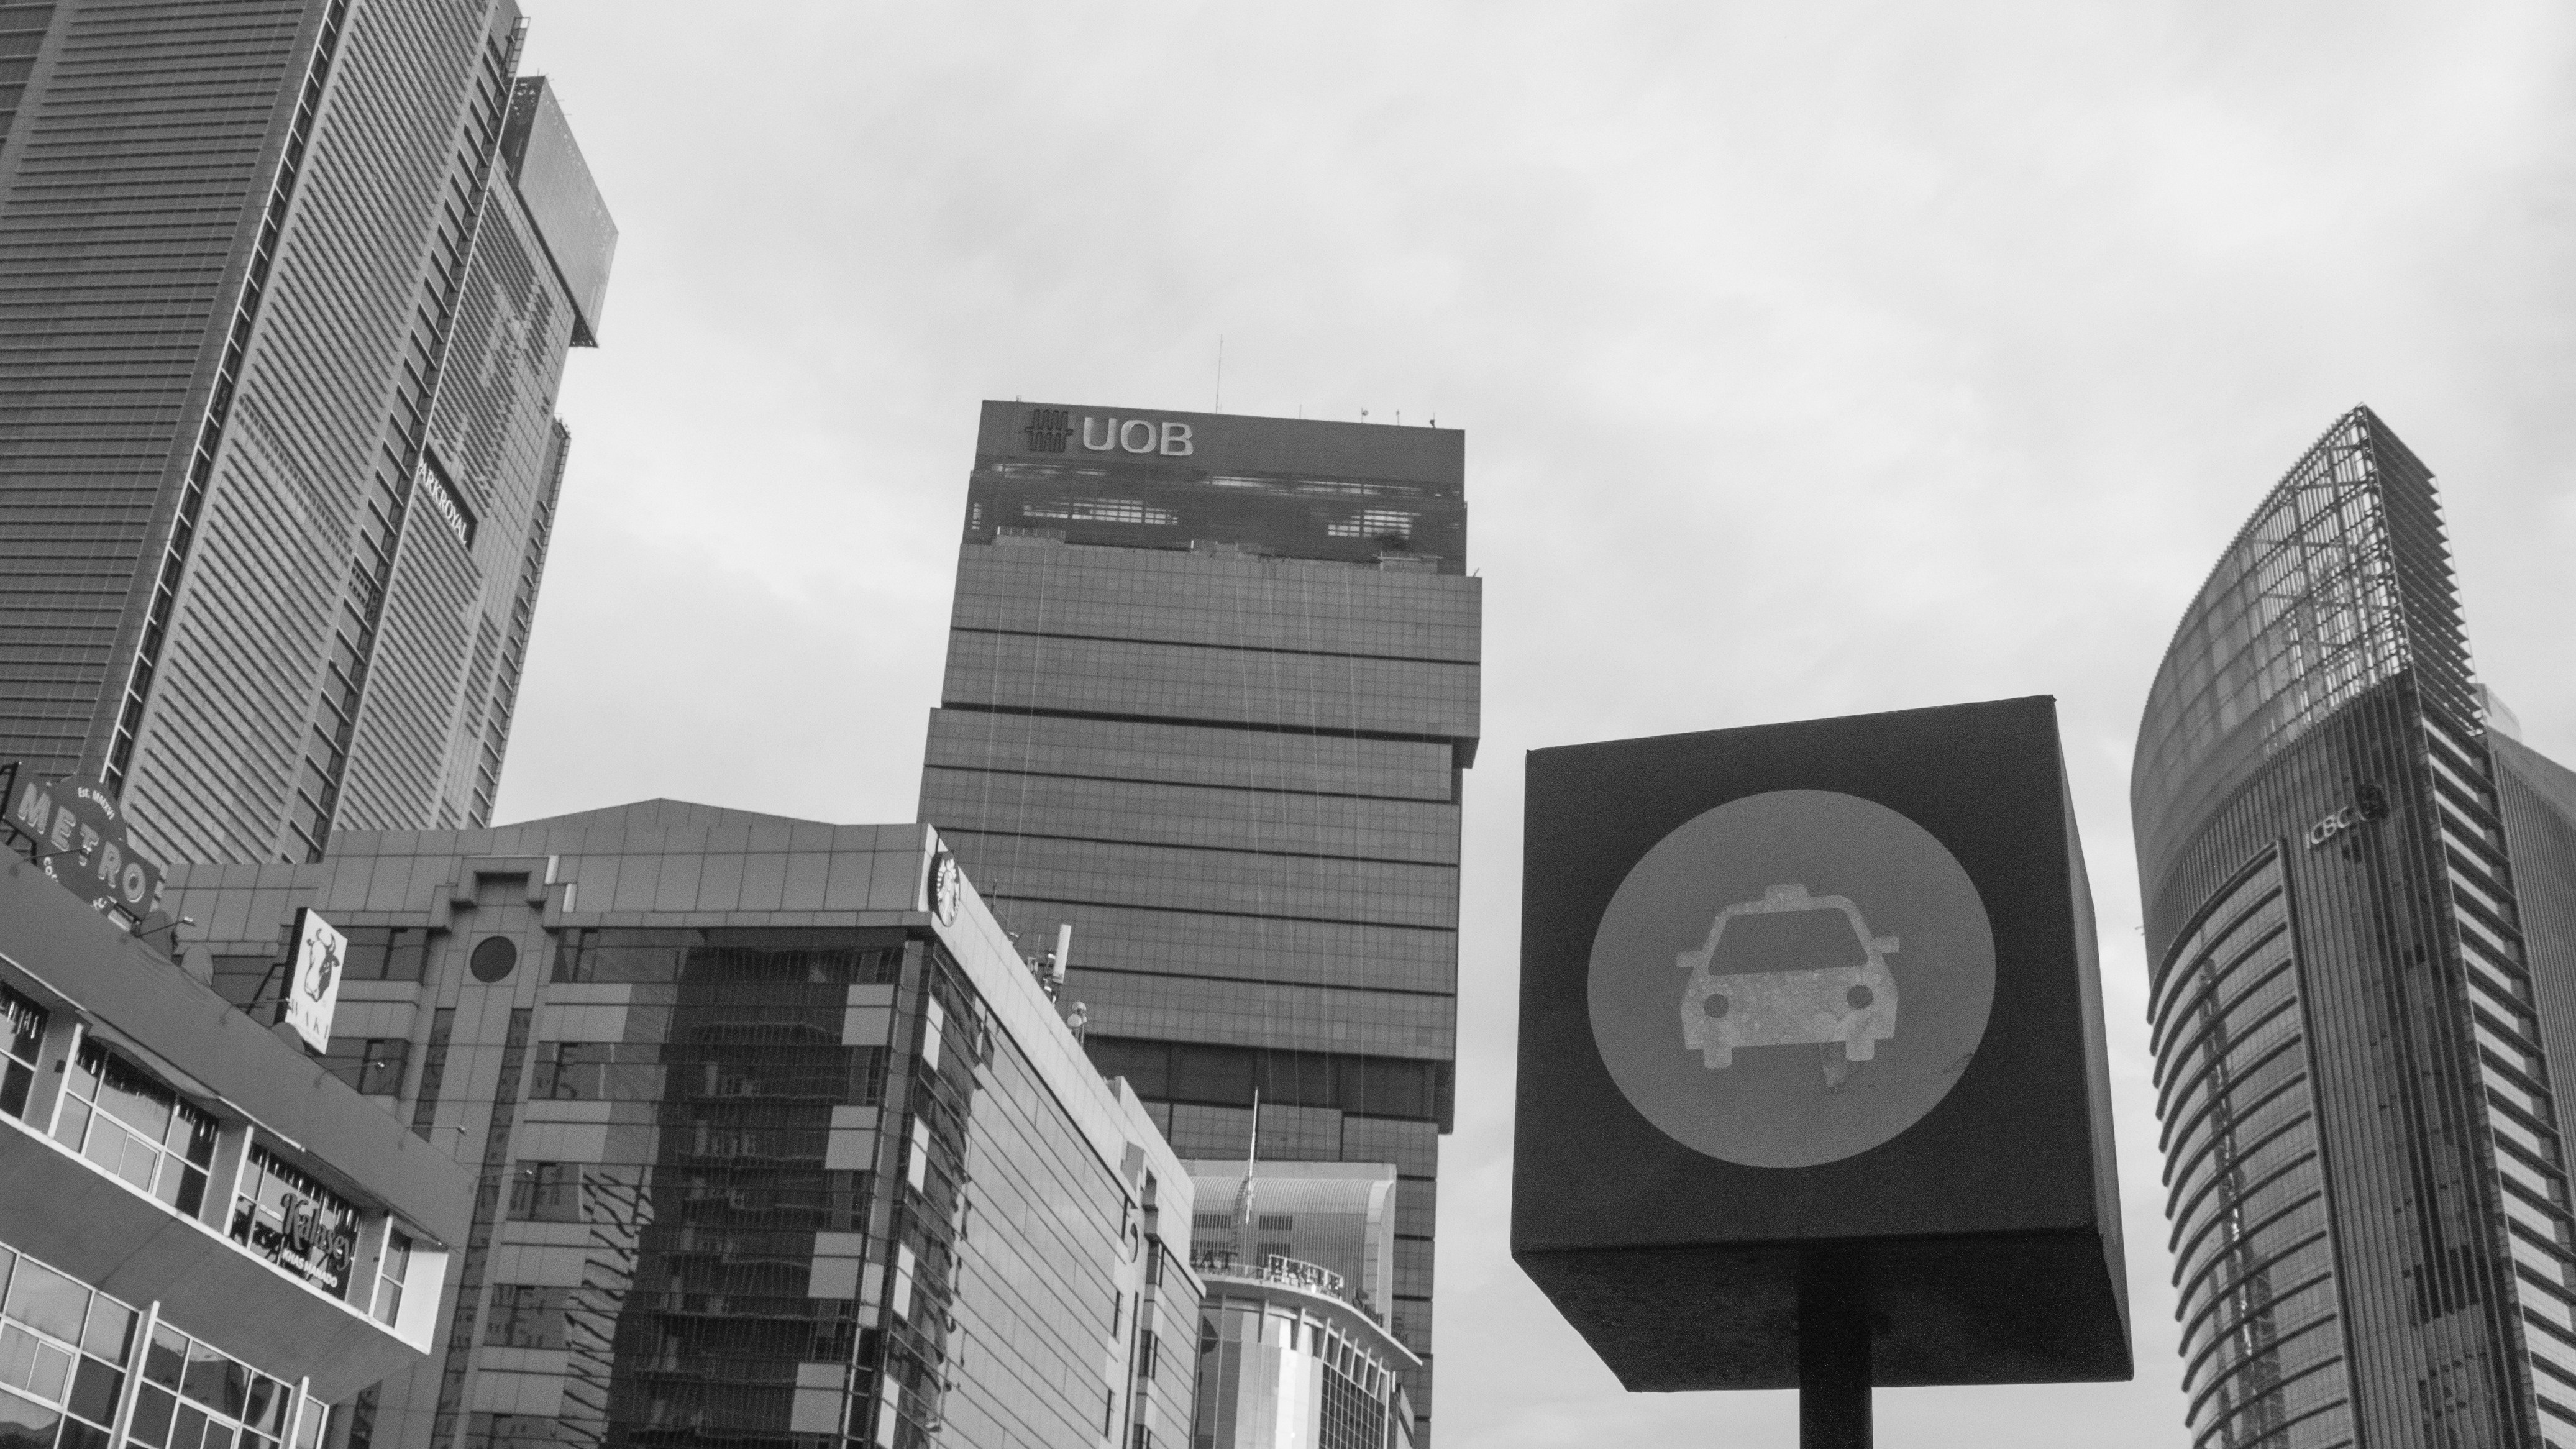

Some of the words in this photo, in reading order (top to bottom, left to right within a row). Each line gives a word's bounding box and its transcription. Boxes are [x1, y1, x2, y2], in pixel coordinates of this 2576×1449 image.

[1083, 416, 1194, 456] UOB
[17, 782, 147, 904] METRO
[2305, 805, 2352, 849] ICBC
[281, 1192, 350, 1271] Kalasey
[283, 1248, 305, 1269] KHAS
[304, 1260, 338, 1288] MANADO
